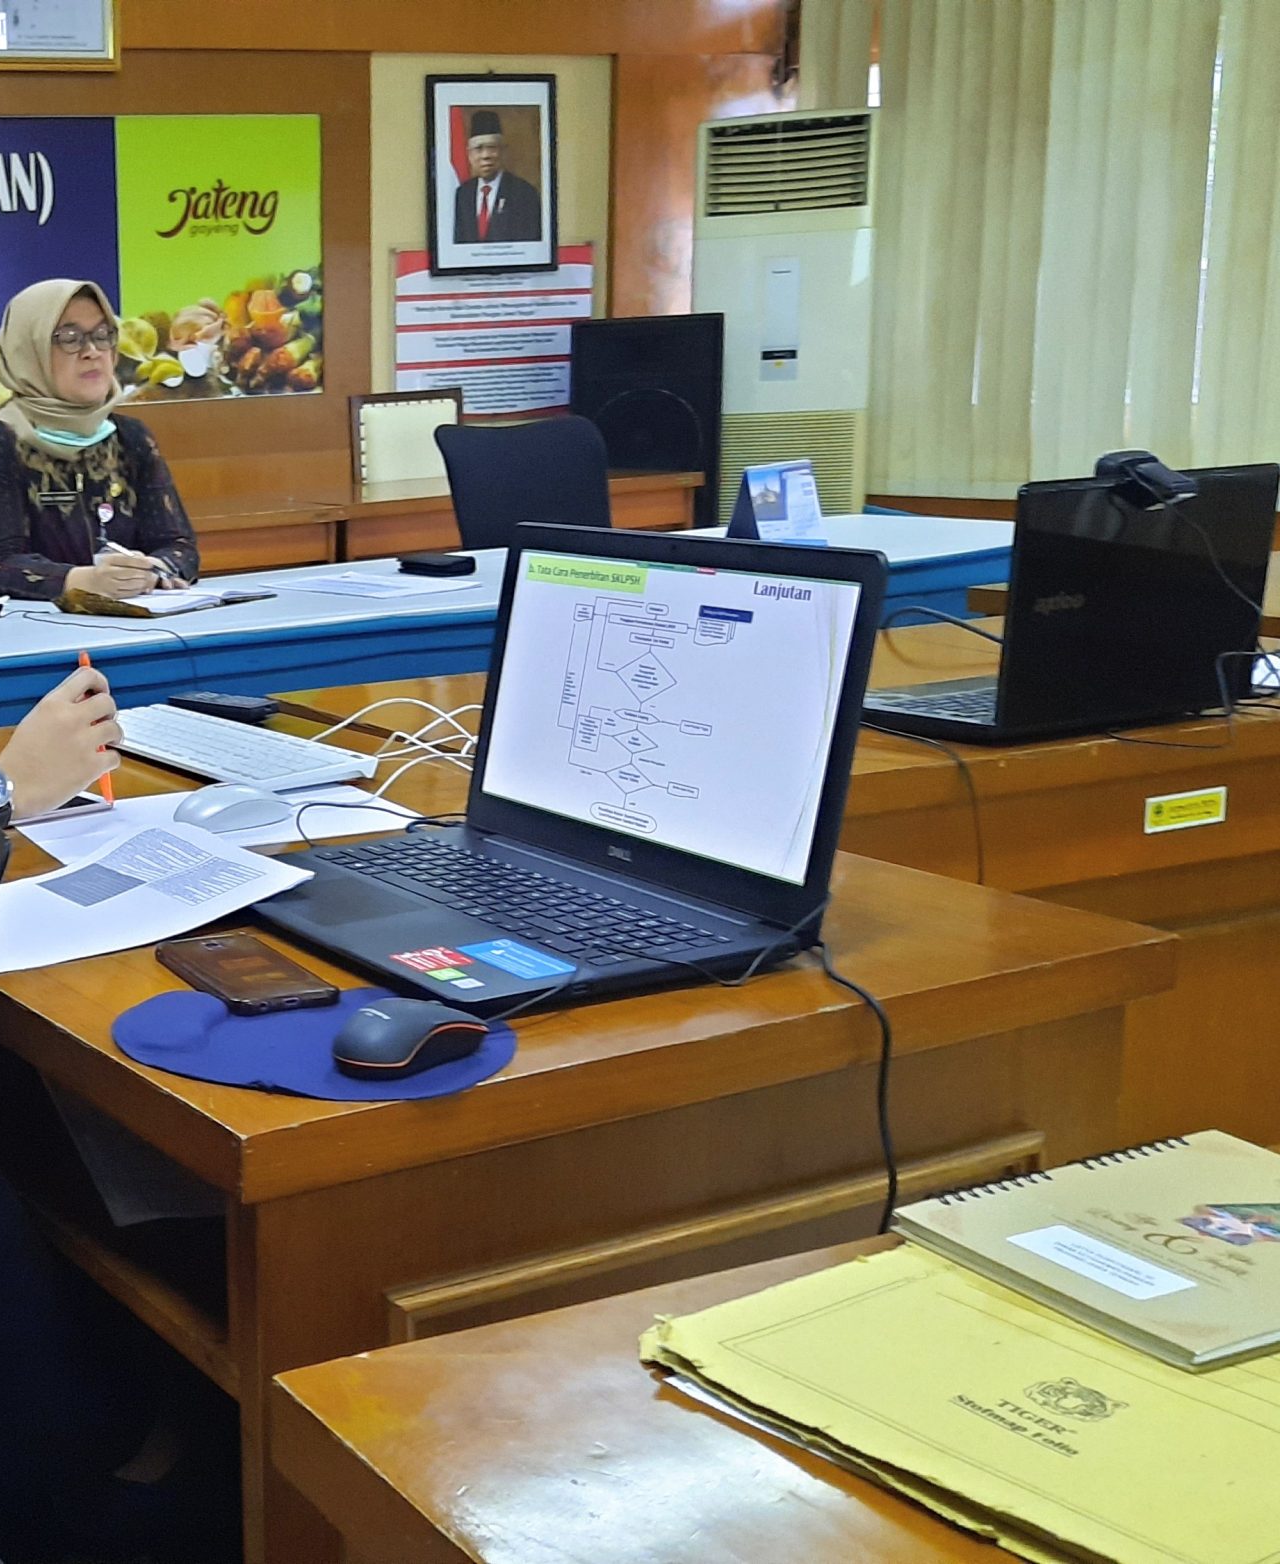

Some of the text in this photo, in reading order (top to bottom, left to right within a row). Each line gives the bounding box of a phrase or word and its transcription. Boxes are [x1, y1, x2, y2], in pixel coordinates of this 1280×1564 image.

[155, 178, 279, 239] Jateng
[537, 564, 552, 575] Tata
[552, 566, 569, 578] Cara
[570, 568, 610, 582] Penerbitan
[753, 580, 812, 601] Lanjutan
[954, 1393, 1080, 1456] Stofmap Folio
[996, 1398, 1068, 1435] TIGER
